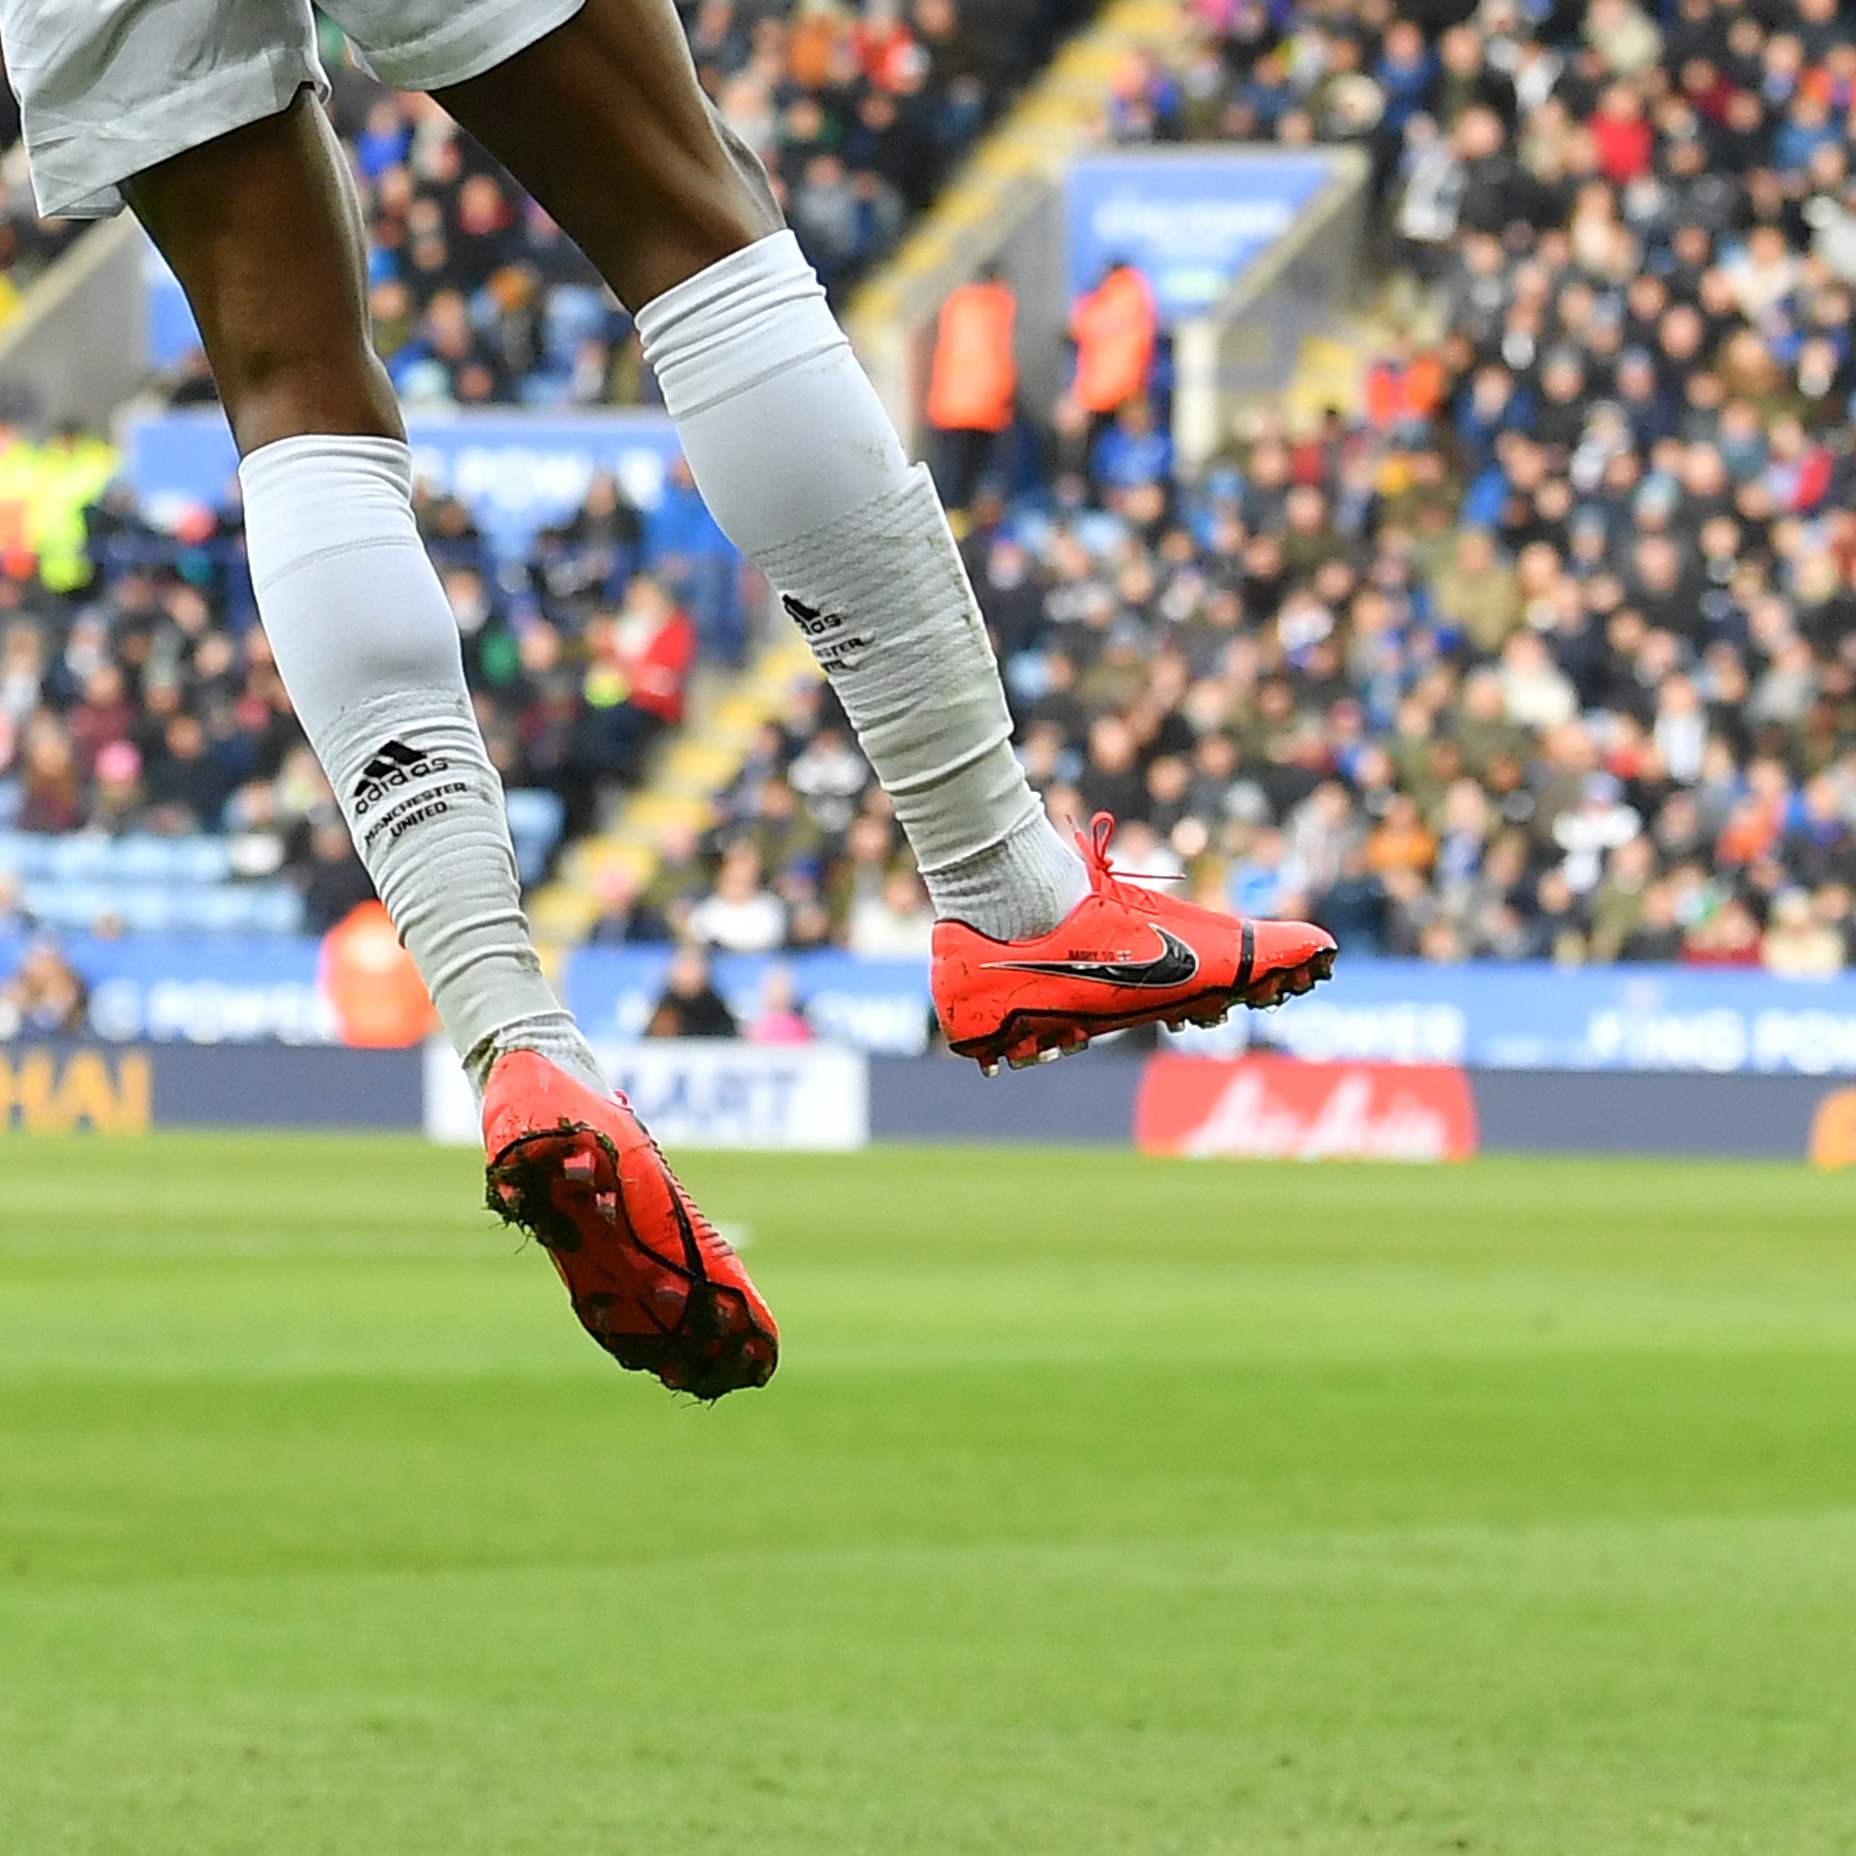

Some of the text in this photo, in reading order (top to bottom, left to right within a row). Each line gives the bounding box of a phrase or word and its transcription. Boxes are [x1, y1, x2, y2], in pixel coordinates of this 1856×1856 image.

[355, 757, 449, 815] adidas
[364, 781, 468, 847] MANCHESTER
[390, 800, 448, 838] UNITED
